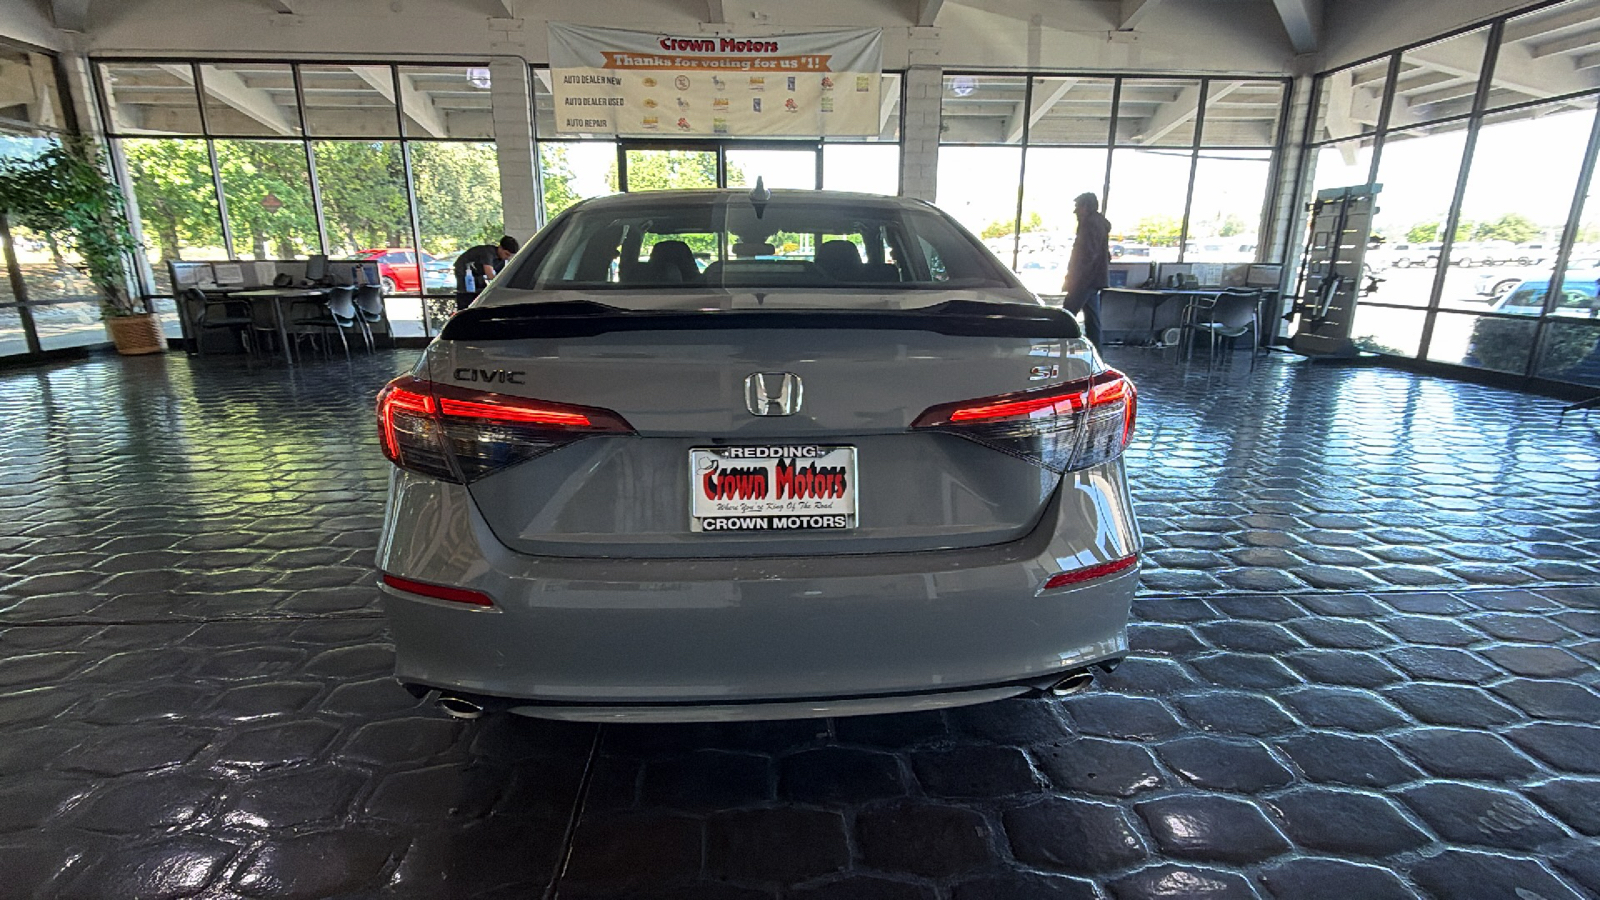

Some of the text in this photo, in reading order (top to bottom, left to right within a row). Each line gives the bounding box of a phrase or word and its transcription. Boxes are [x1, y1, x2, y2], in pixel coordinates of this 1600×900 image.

[660, 38, 779, 53] Crown Motors
[614, 54, 671, 67] Thanks
[675, 58, 698, 68] for
[701, 60, 750, 70] voting
[754, 58, 777, 68] for
[780, 60, 798, 68] us
[563, 75, 622, 85] AUTO DEALER NEW
[565, 97, 624, 106] AUTO DEALER USED
[566, 119, 607, 128] AUTO REPAIR
[453, 368, 526, 385] CIVIC
[730, 447, 816, 458] REDDING
[703, 457, 847, 501] Crown Motors
[717, 501, 833, 513] Where You're King Of The Road
[703, 516, 846, 530] CROWN MOTORS
